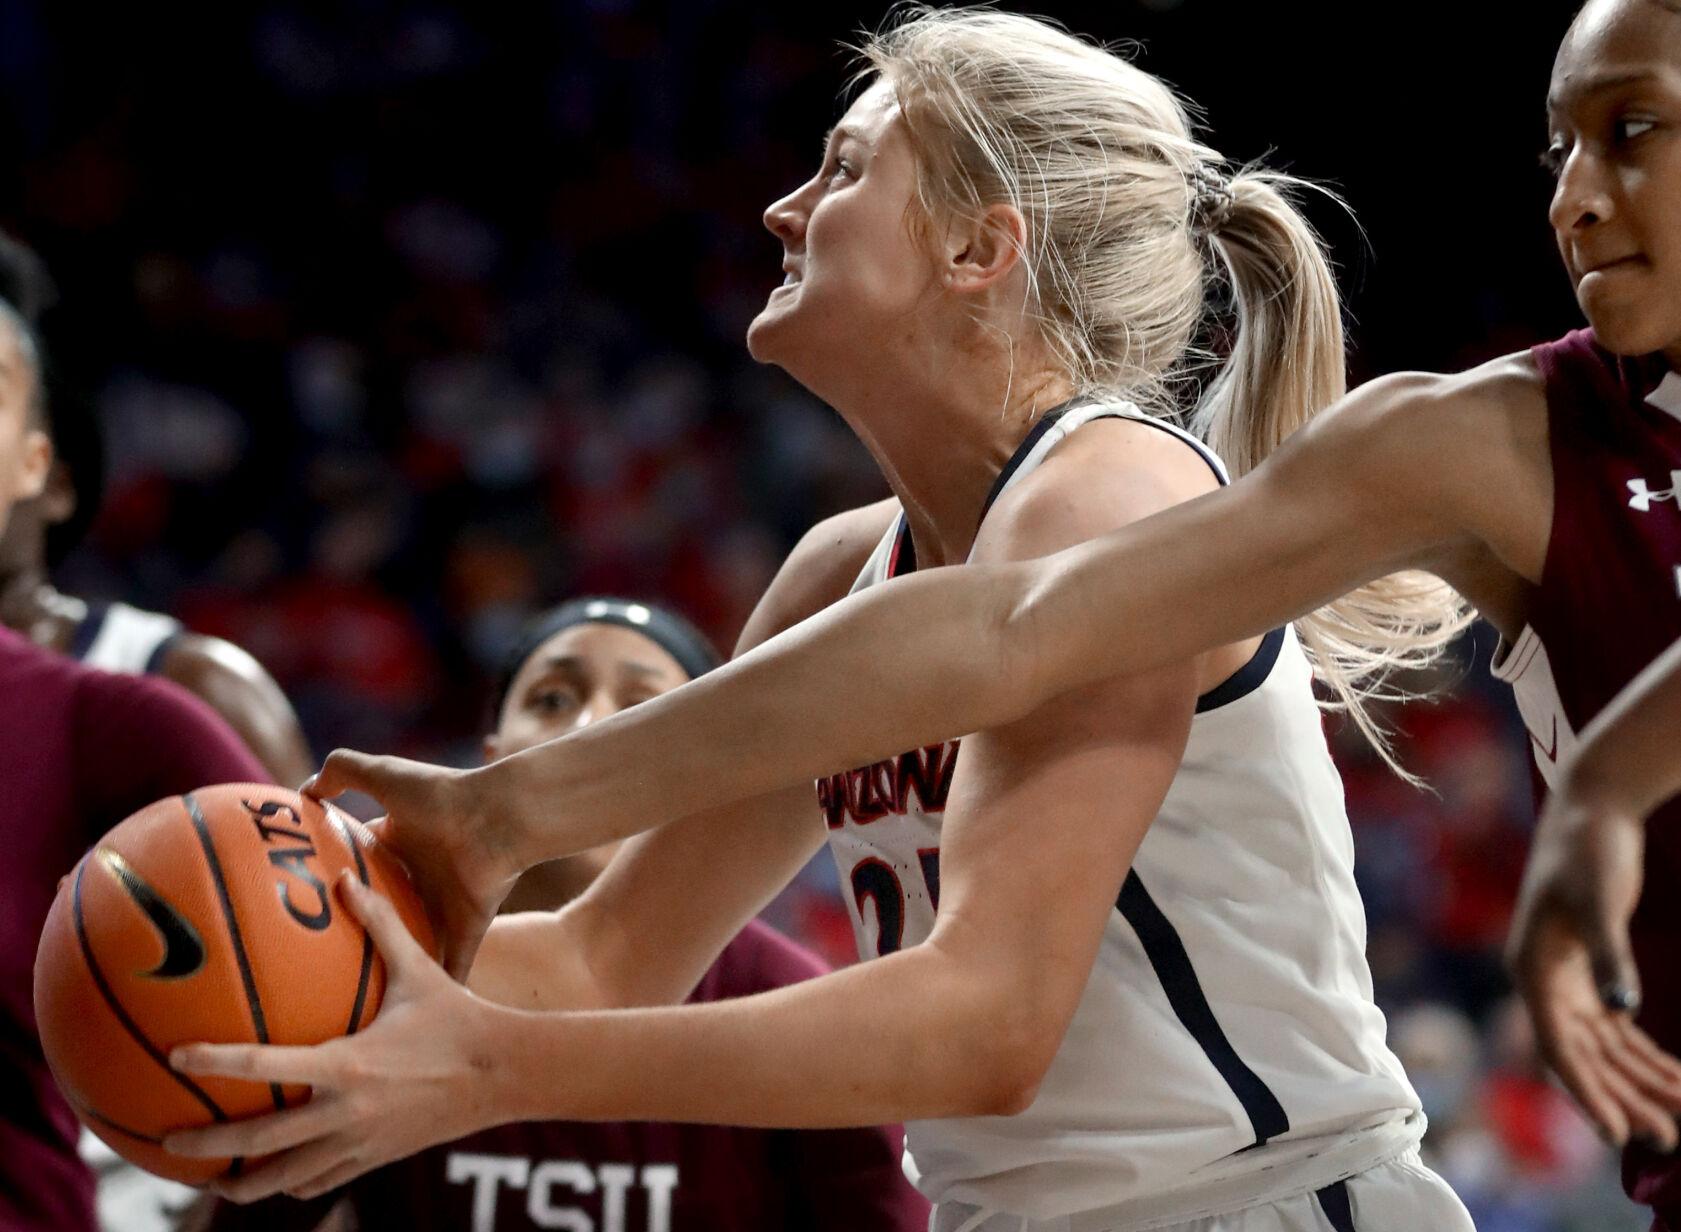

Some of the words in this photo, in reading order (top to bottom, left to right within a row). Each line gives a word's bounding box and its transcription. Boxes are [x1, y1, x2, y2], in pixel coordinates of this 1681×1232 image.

[241, 799, 332, 932] CATS
[850, 847, 941, 957] 2
[446, 1152, 679, 1232] TSU
